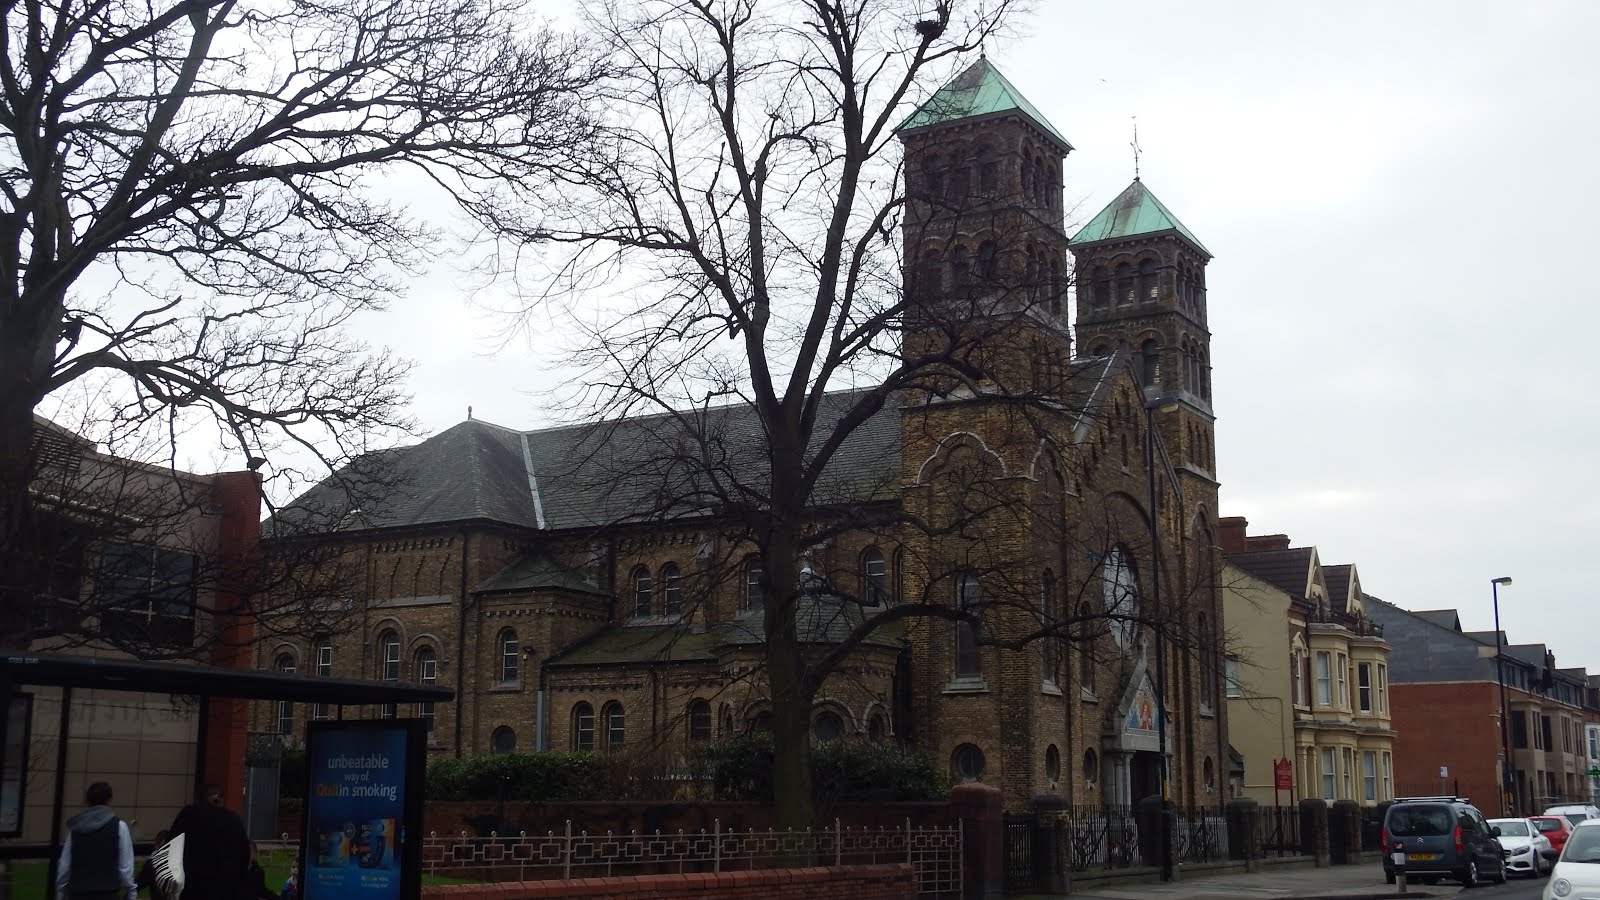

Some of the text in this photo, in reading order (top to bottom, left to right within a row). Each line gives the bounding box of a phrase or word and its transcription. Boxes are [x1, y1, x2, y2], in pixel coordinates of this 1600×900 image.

[328, 754, 389, 768] unbeatable
[344, 771, 369, 783] way of
[352, 784, 397, 801] smoking
